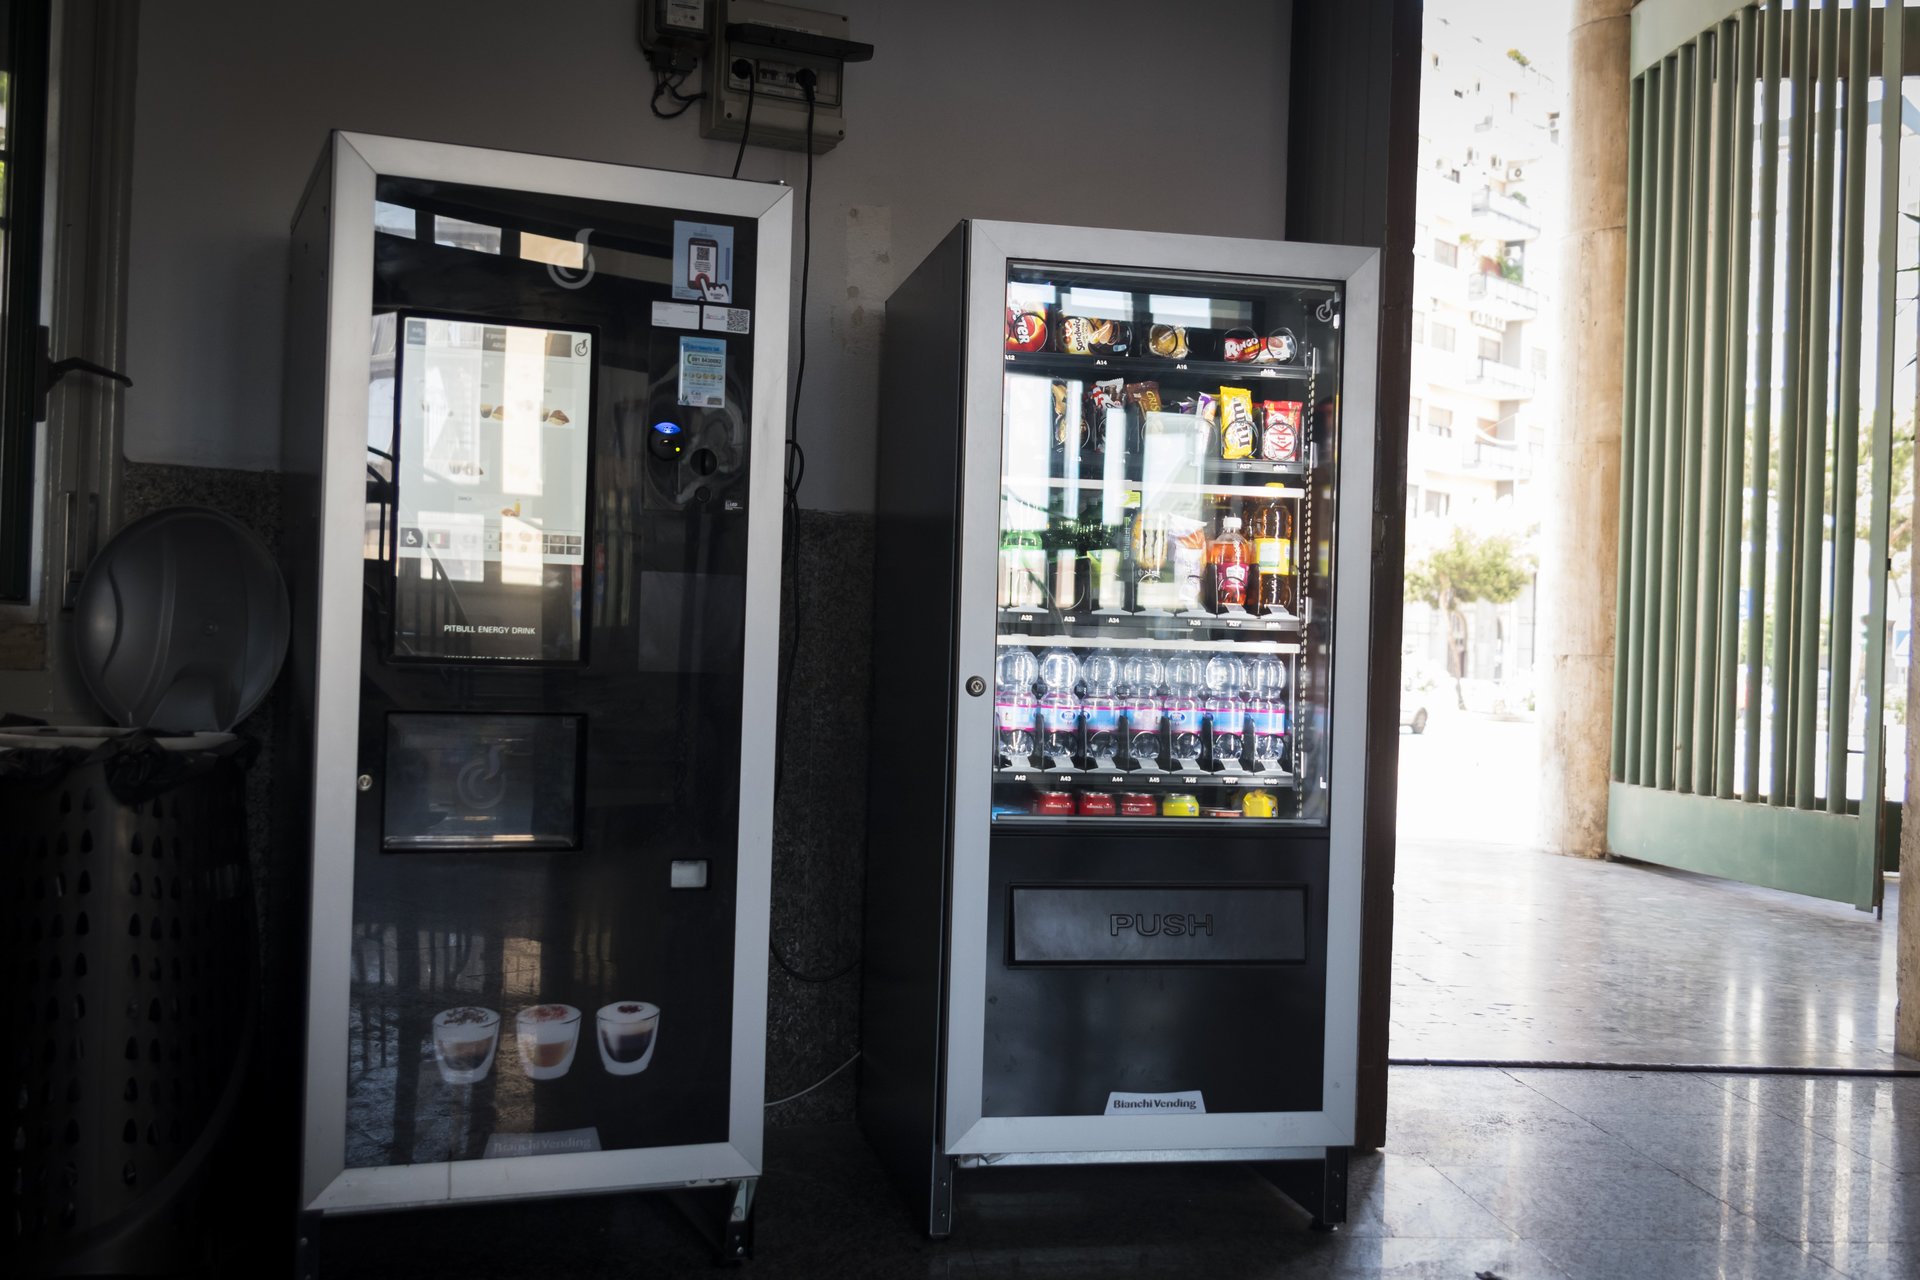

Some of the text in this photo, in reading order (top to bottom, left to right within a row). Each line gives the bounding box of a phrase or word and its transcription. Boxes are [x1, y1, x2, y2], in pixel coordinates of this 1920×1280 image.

[1226, 338, 1258, 357] RINGO
[443, 624, 536, 635] PITBULL ENERGY DRINK
[1014, 774, 1027, 782] A42
[1110, 913, 1214, 937] PUSH
[1113, 1098, 1197, 1110] Bianchi Vending
[493, 1135, 592, 1153] Bianchi Vending
